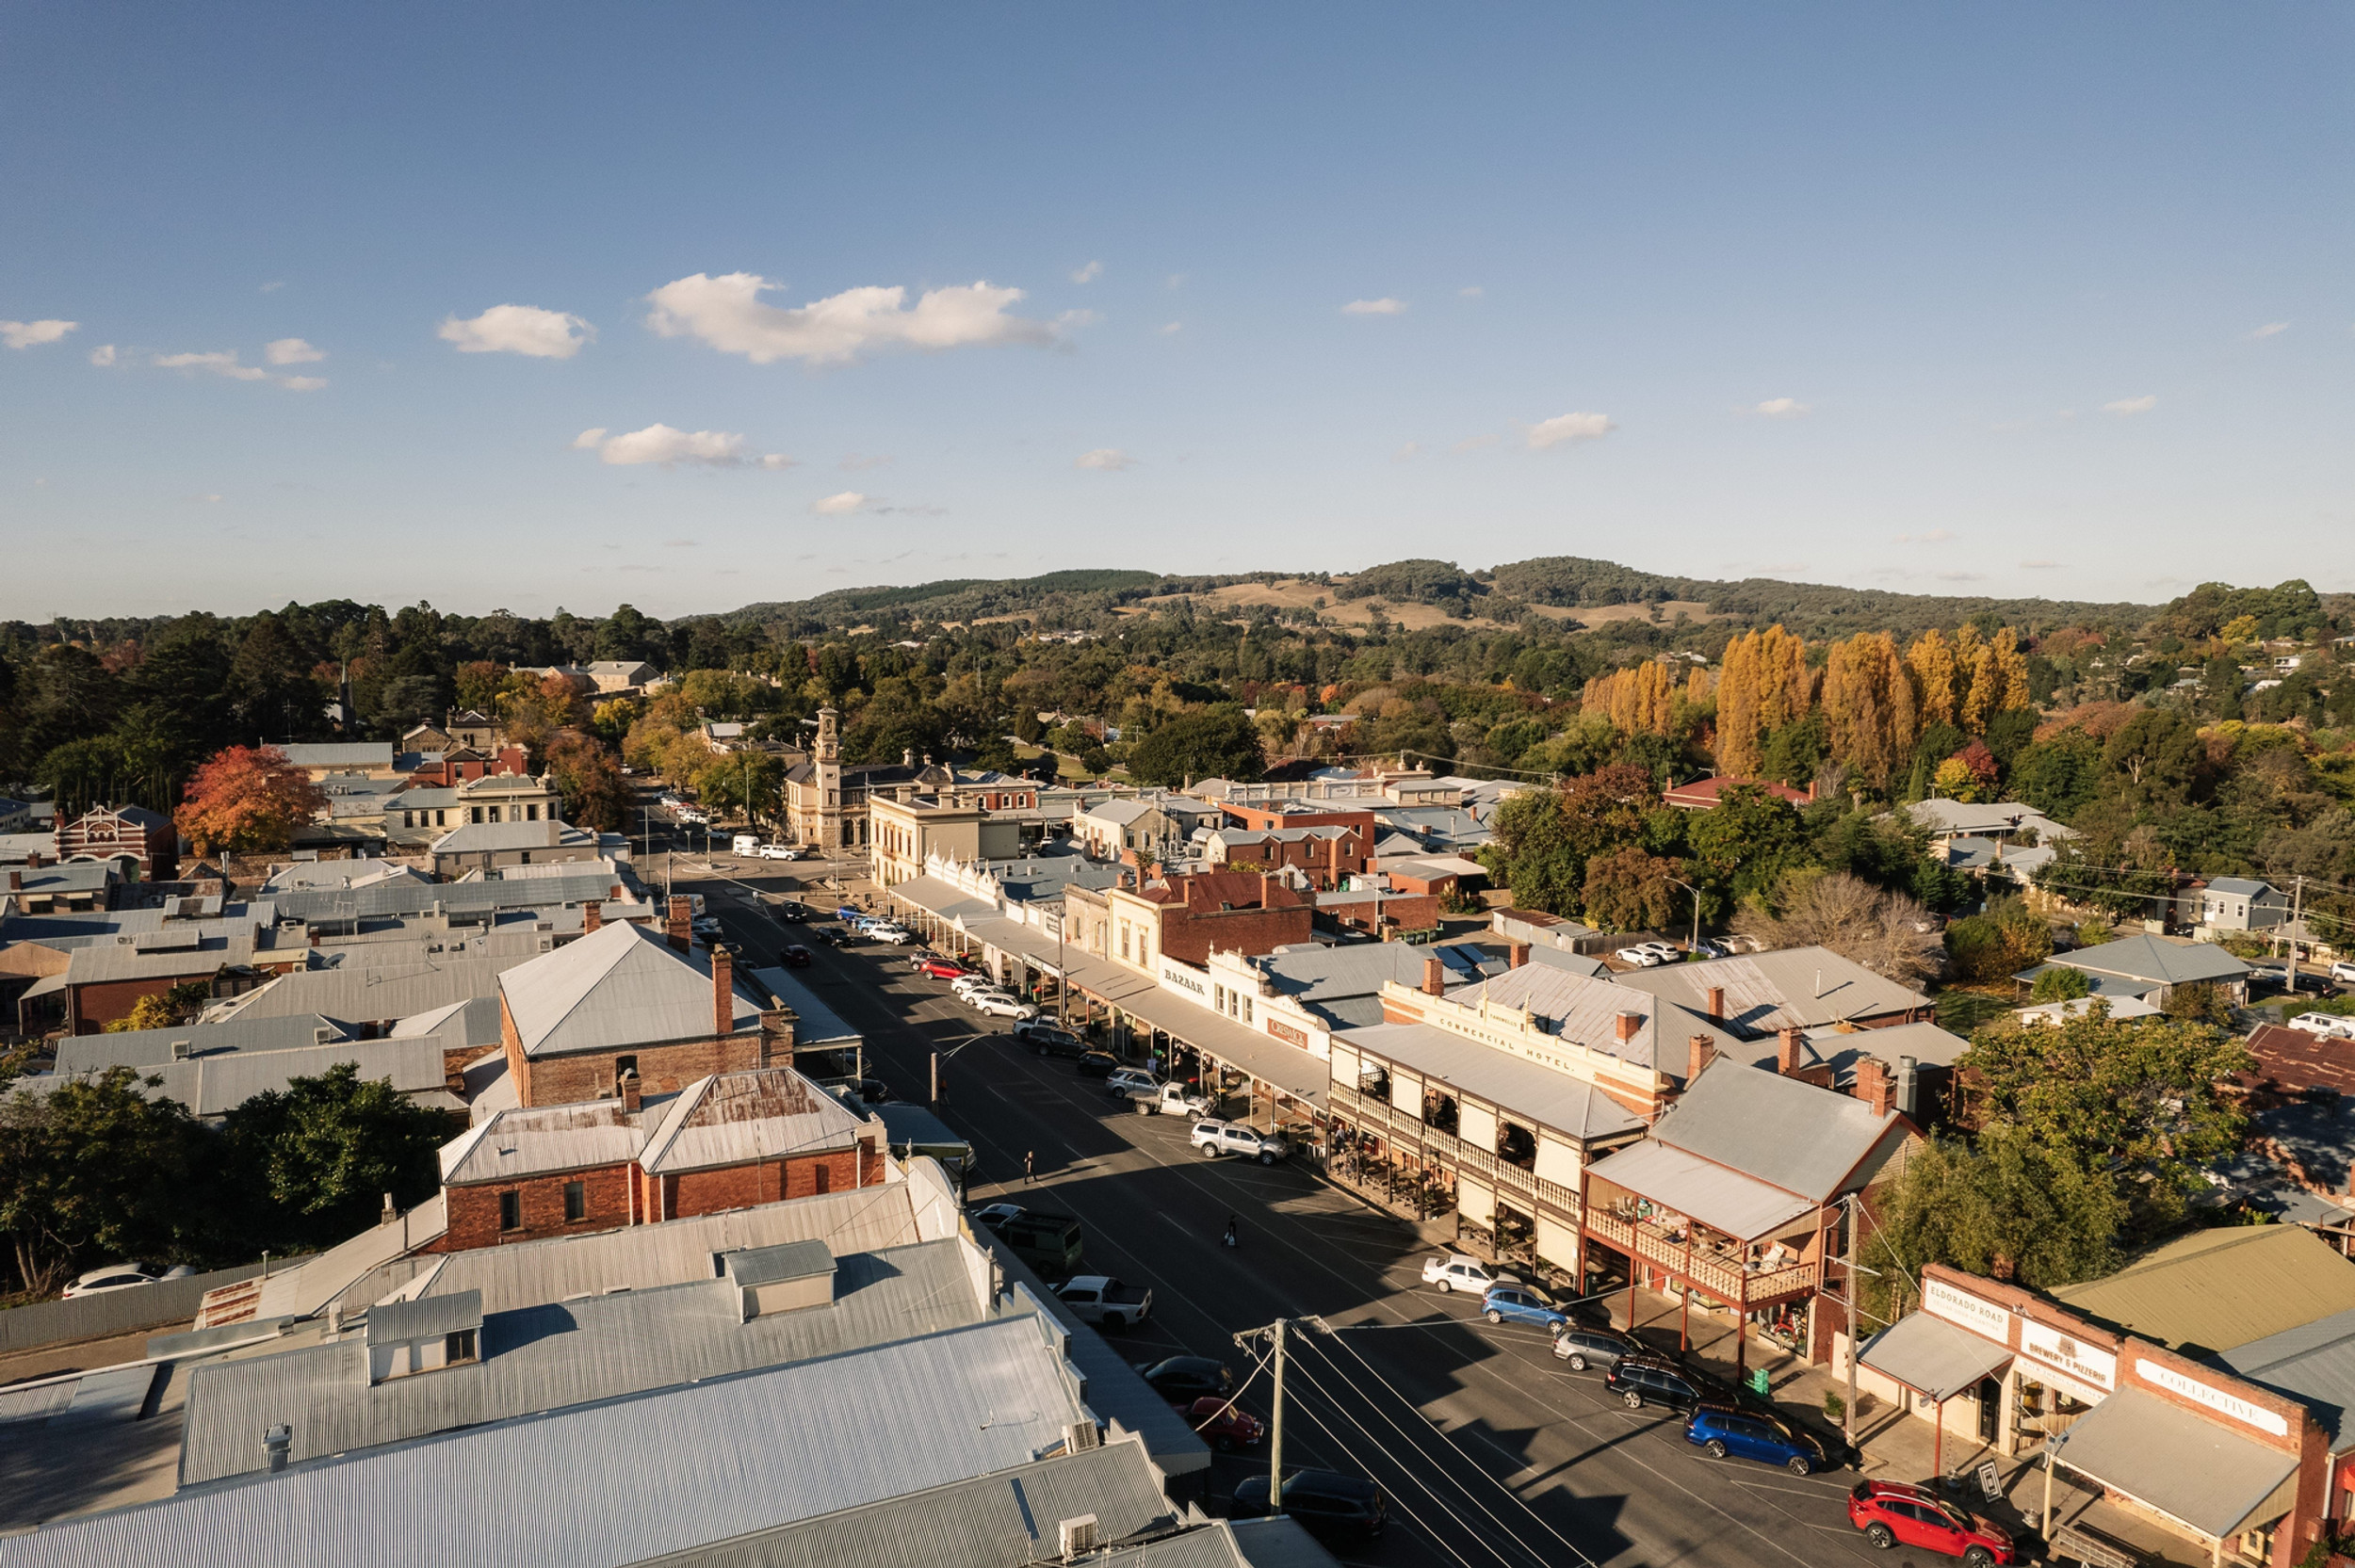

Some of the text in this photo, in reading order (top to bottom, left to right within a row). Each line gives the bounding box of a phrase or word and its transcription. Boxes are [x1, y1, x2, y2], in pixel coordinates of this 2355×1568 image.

[1164, 969, 1205, 995] BAZAAR
[1439, 1018, 1515, 1050] COMMERCIAL
[1930, 1286, 2004, 1323] ELDORADO ROAD
[2028, 1342, 2063, 1364] BREWERY
[2072, 1361, 2107, 1383] PIZZERIA
[2160, 1372, 2259, 1422] COLLECTIVE
